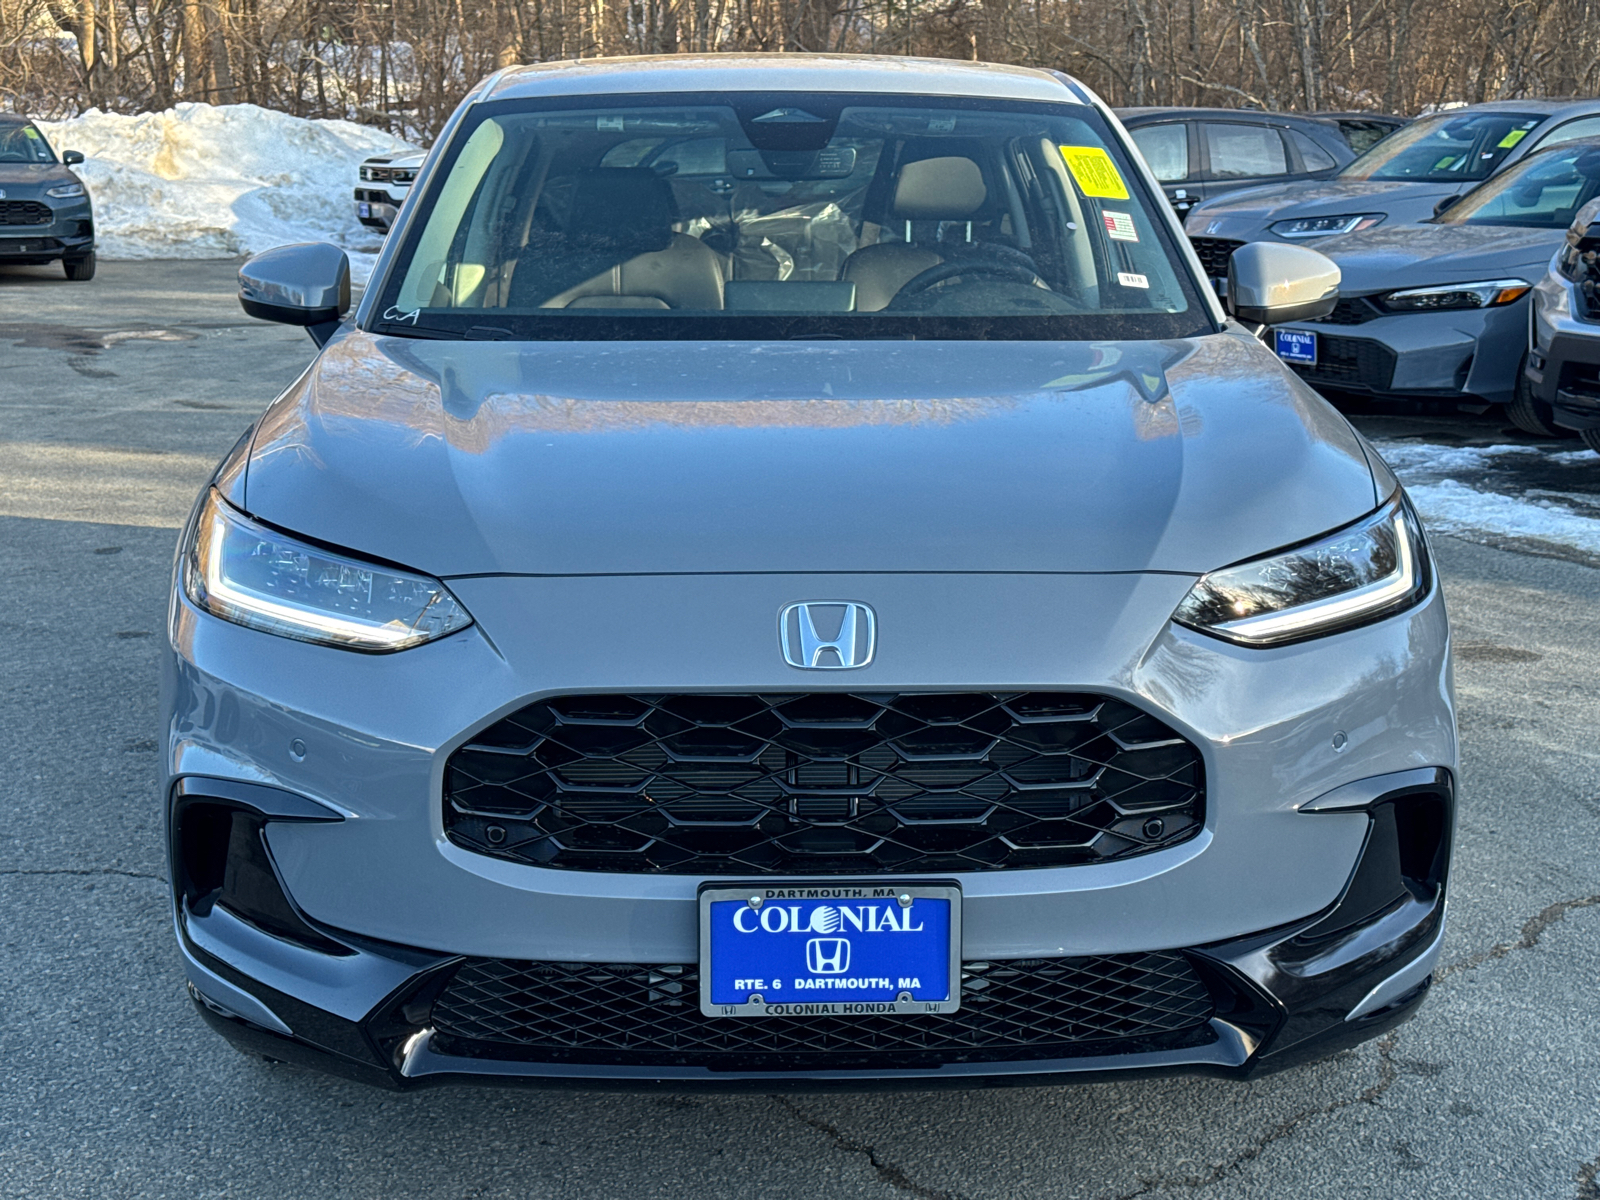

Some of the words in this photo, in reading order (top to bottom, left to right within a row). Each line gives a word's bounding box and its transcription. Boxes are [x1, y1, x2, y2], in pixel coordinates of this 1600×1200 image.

[765, 889, 869, 899] DARTMOUTH,
[872, 888, 896, 898] MA
[732, 905, 924, 934] COLONIAL
[734, 979, 768, 990] RTE.
[772, 979, 782, 990] 6
[794, 978, 894, 991] DARTMOUTH,
[898, 977, 922, 989] MA
[765, 1003, 838, 1015] COLONIAL
[843, 1002, 897, 1014] HONDA
